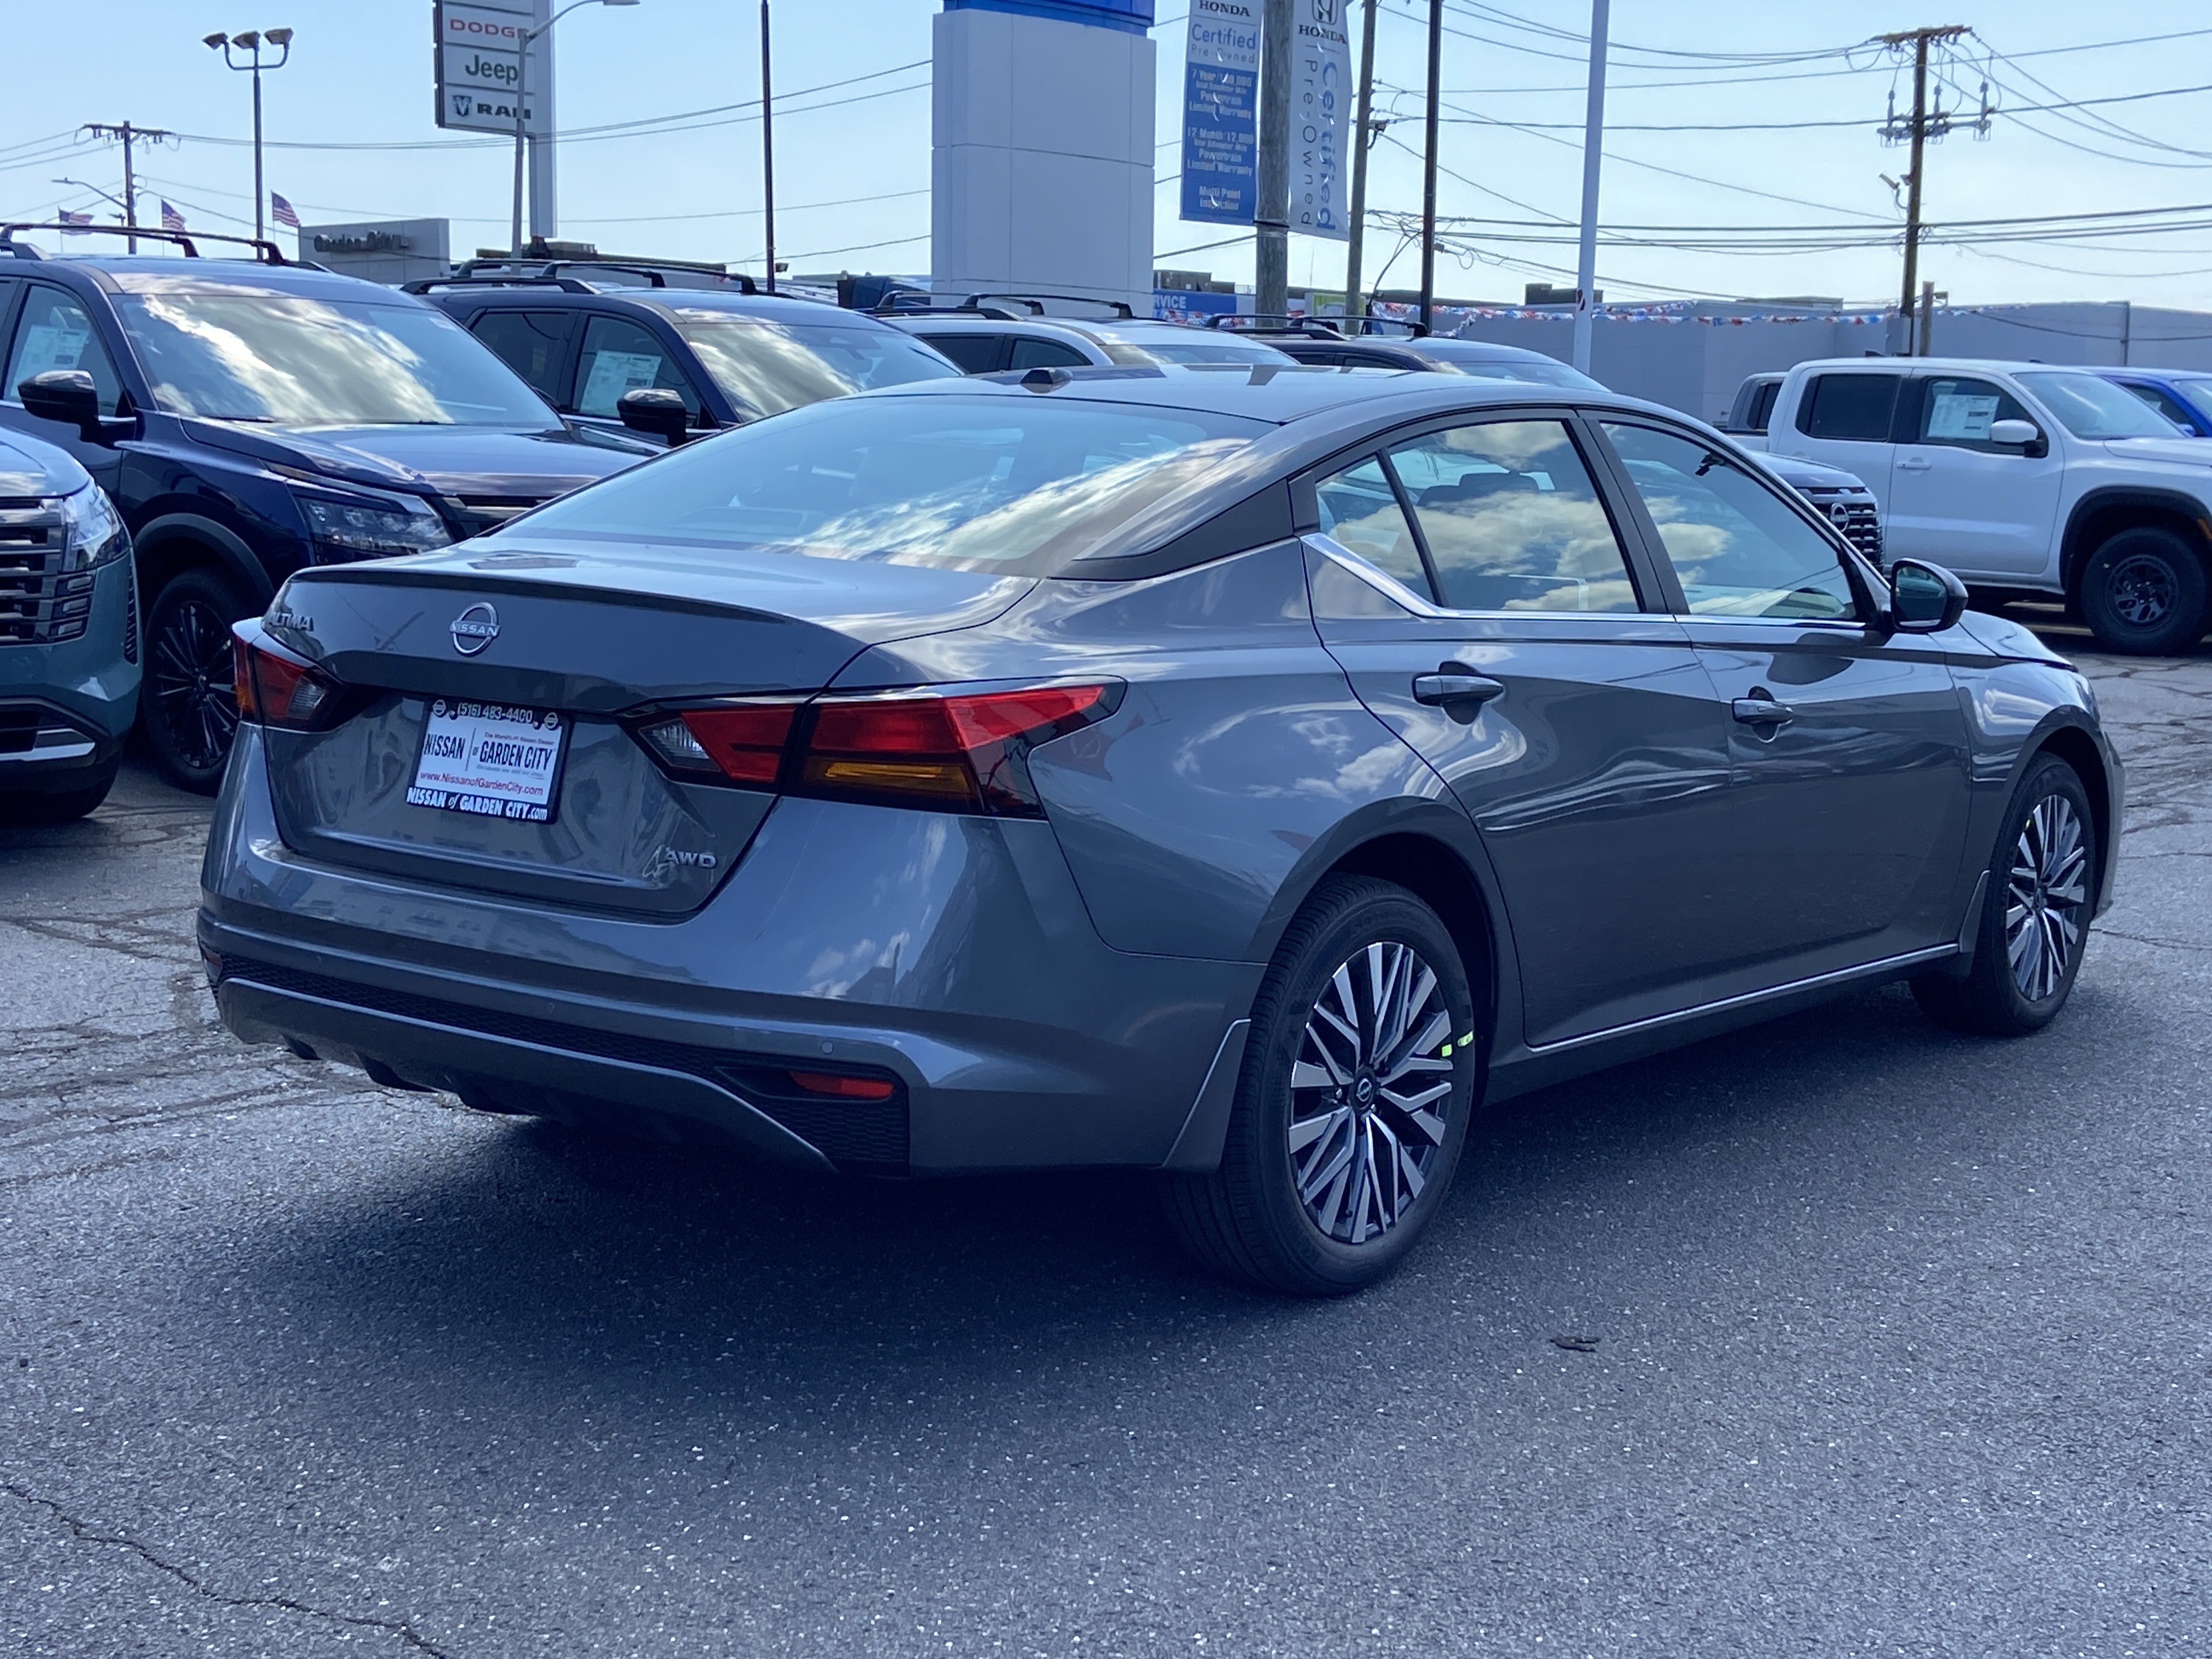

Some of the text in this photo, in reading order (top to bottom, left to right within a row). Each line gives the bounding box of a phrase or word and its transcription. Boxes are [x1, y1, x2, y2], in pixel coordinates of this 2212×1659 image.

[1199, 0, 1251, 17] HONDA
[1192, 24, 1256, 50] Certified
[1298, 24, 1347, 44] HONDA
[465, 55, 518, 84] Jeep
[1318, 61, 1339, 230] Certified
[265, 611, 314, 631] ALTIMA
[452, 622, 498, 637] NISSAN
[424, 733, 466, 759] NISSAN
[479, 741, 524, 767] GARDEN
[524, 746, 552, 771] CITY
[406, 787, 447, 808] NISSAN
[459, 794, 504, 815] GARDEN
[665, 850, 718, 868] AWD
